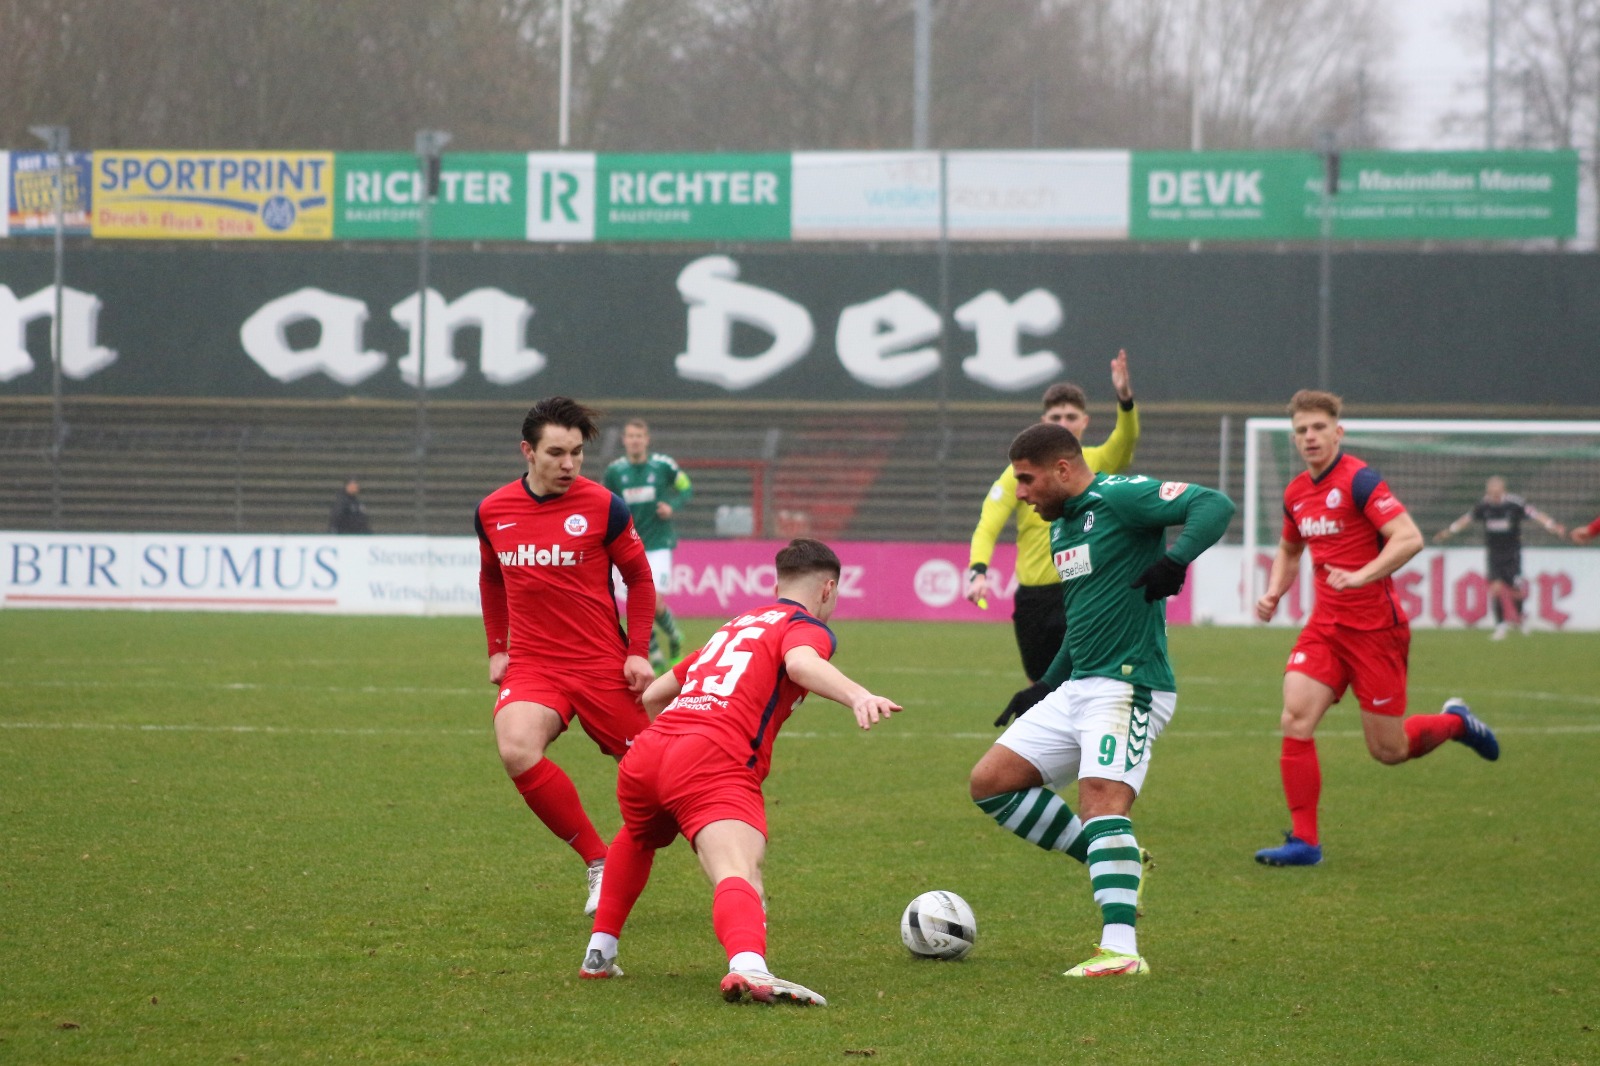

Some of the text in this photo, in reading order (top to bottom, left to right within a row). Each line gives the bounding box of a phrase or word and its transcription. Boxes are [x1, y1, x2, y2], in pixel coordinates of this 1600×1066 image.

[100, 157, 325, 191] SPORTPRINT
[609, 171, 778, 204] RICHTER
[1148, 171, 1264, 205] DEVK
[240, 287, 547, 387] an
[10, 543, 339, 591] BTR SUMUS
[681, 626, 766, 697] 25
[1097, 734, 1117, 766] 9
